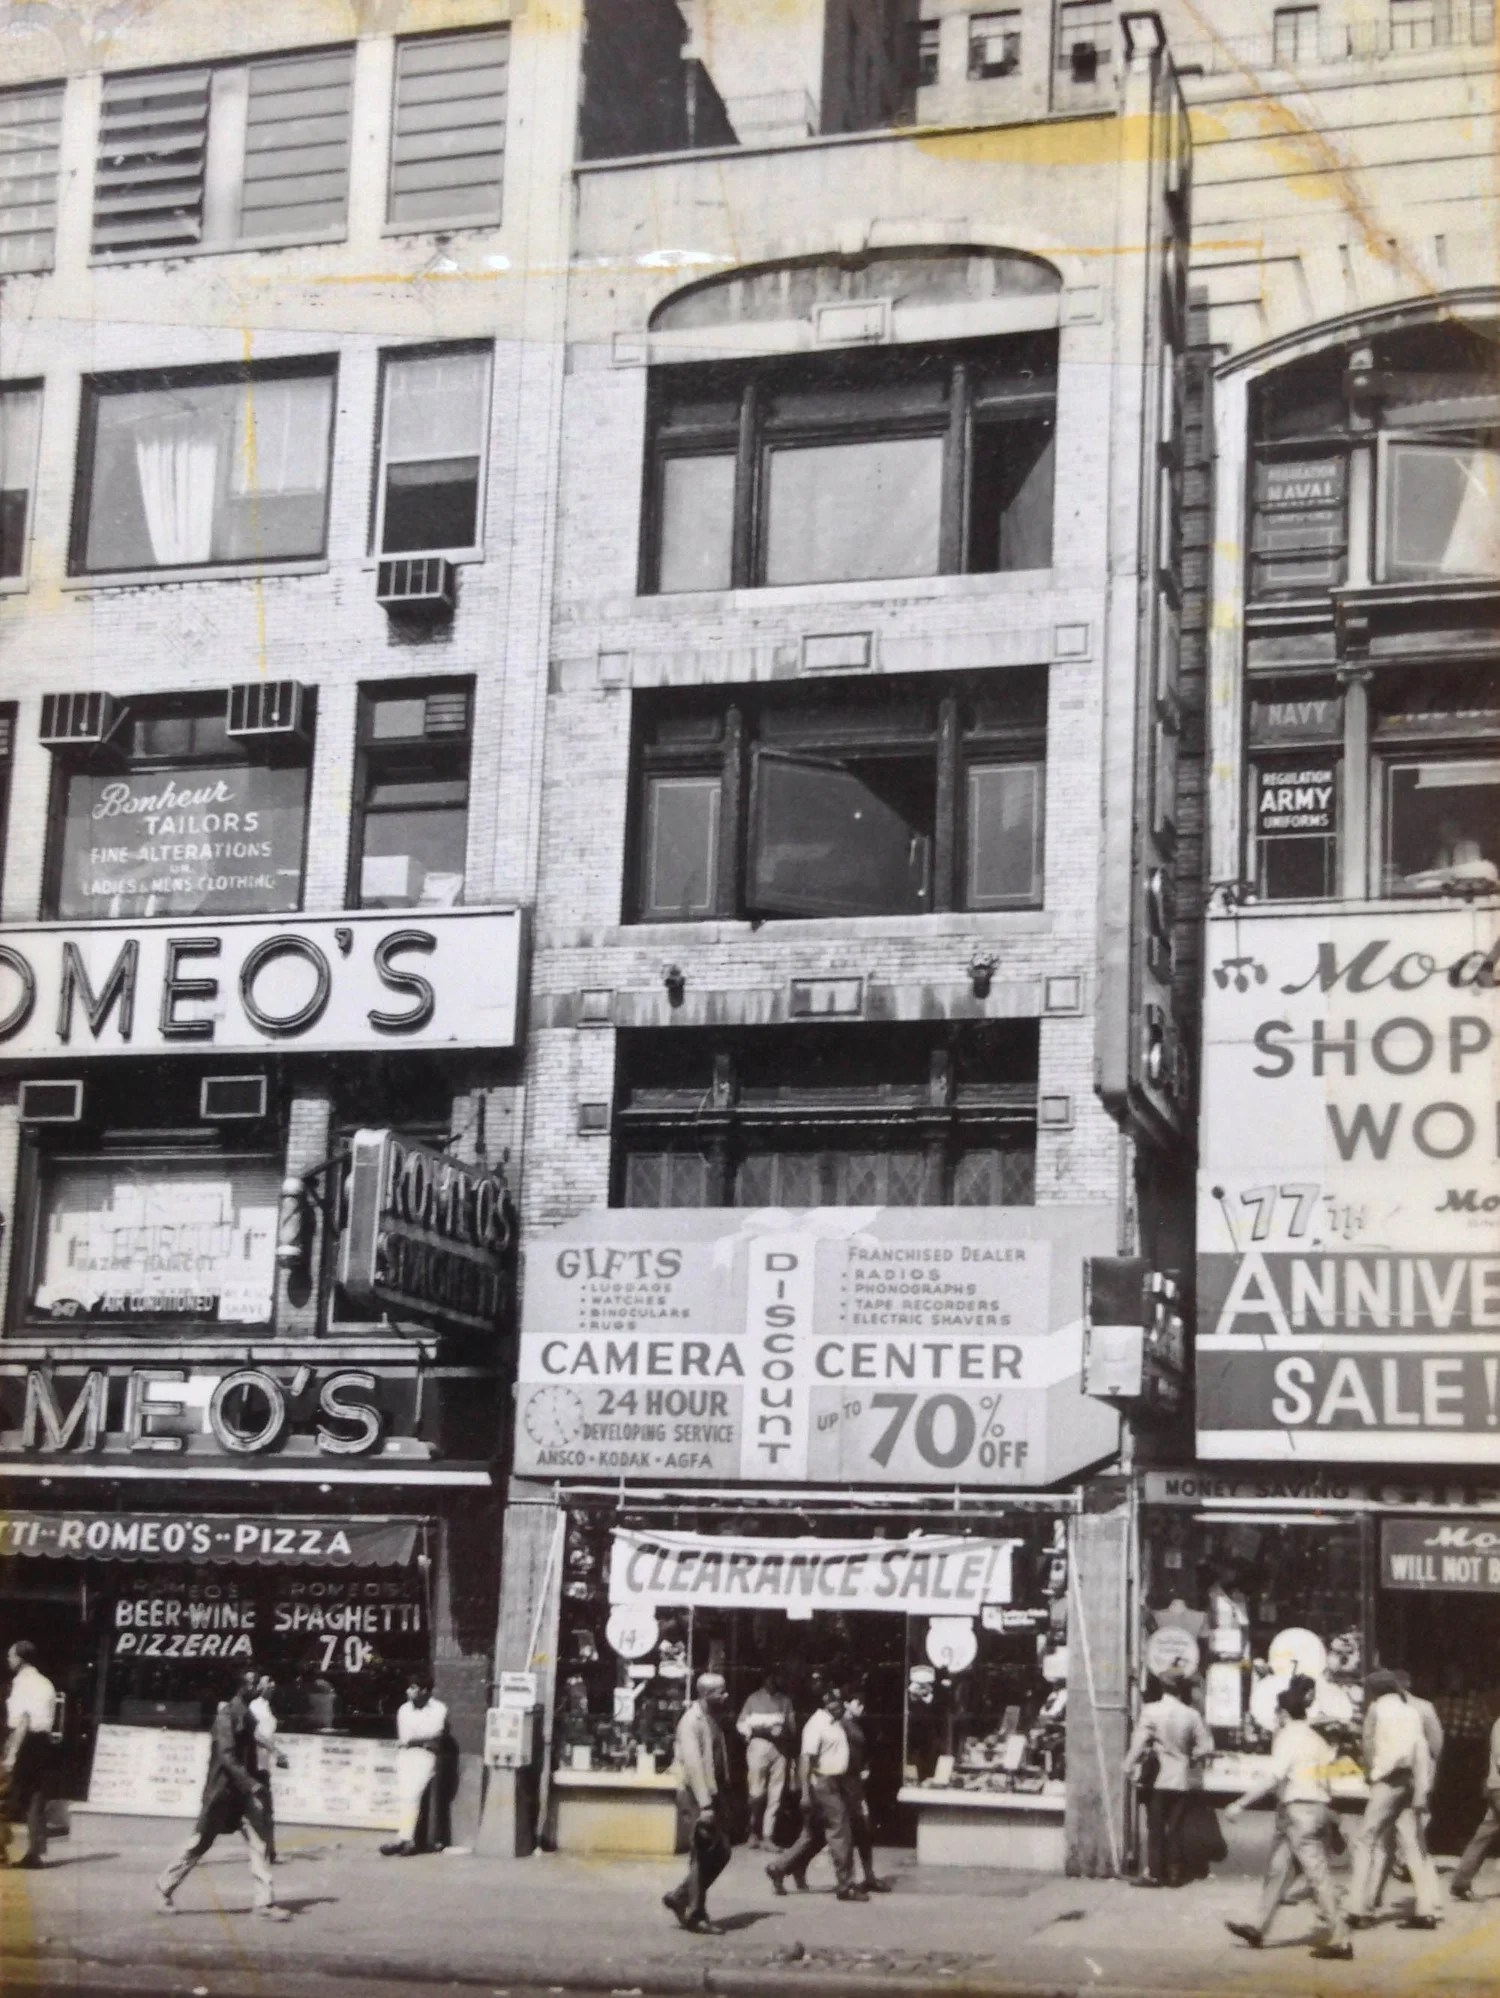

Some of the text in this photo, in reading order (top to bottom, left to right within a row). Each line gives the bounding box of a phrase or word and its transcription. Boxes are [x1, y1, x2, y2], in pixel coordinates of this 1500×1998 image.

[1267, 701, 1327, 727] NAVY
[1262, 770, 1332, 786] REGULATION
[92, 780, 236, 820] Bonheur
[1260, 786, 1333, 812] ARMY
[143, 811, 259, 836] TAILORS
[1262, 813, 1330, 829] UNIFORMS
[90, 841, 272, 864] FINE ALTERATIONS
[83, 878, 137, 896] LADIES
[199, 875, 277, 891] CLOTHING
[1252, 1016, 1492, 1078] SHOP
[1325, 1100, 1500, 1162] WO
[556, 1247, 683, 1279] GIFTS
[849, 1246, 1026, 1262] FRANCHISED DEALER
[854, 1268, 941, 1281] RADIOS
[591, 1296, 667, 1305] WATCHES
[854, 1283, 977, 1295] PHONOGRAPHS
[1215, 1252, 1500, 1335] ANNIVE
[590, 1308, 691, 1318] BINOCULARS
[855, 1300, 1000, 1311] TAPE RECORDERS
[590, 1321, 637, 1330] RUGS
[852, 1314, 1011, 1325] ELECTRIC SHAVERS
[540, 1340, 1024, 1380] CAMERA CENTER
[597, 1388, 729, 1417] 24 HOUR
[583, 1422, 734, 1443] DEVELOPING SERVICE
[816, 1411, 839, 1431] UP
[842, 1400, 862, 1420] TO
[978, 1440, 1029, 1469] OFF
[536, 1450, 713, 1469] ANSCO KODAK AGFA
[1164, 1479, 1238, 1497] MONEY
[58, 1519, 211, 1553] ROMEO'S
[233, 1526, 352, 1555] PIZZA
[625, 1542, 1000, 1602] CLEARANCE SALE!
[1390, 1554, 1437, 1581] WILL
[1442, 1555, 1483, 1583] NOT
[273, 1602, 421, 1633] SPAGHETTI
[115, 1632, 253, 1658] PIZZERIA
